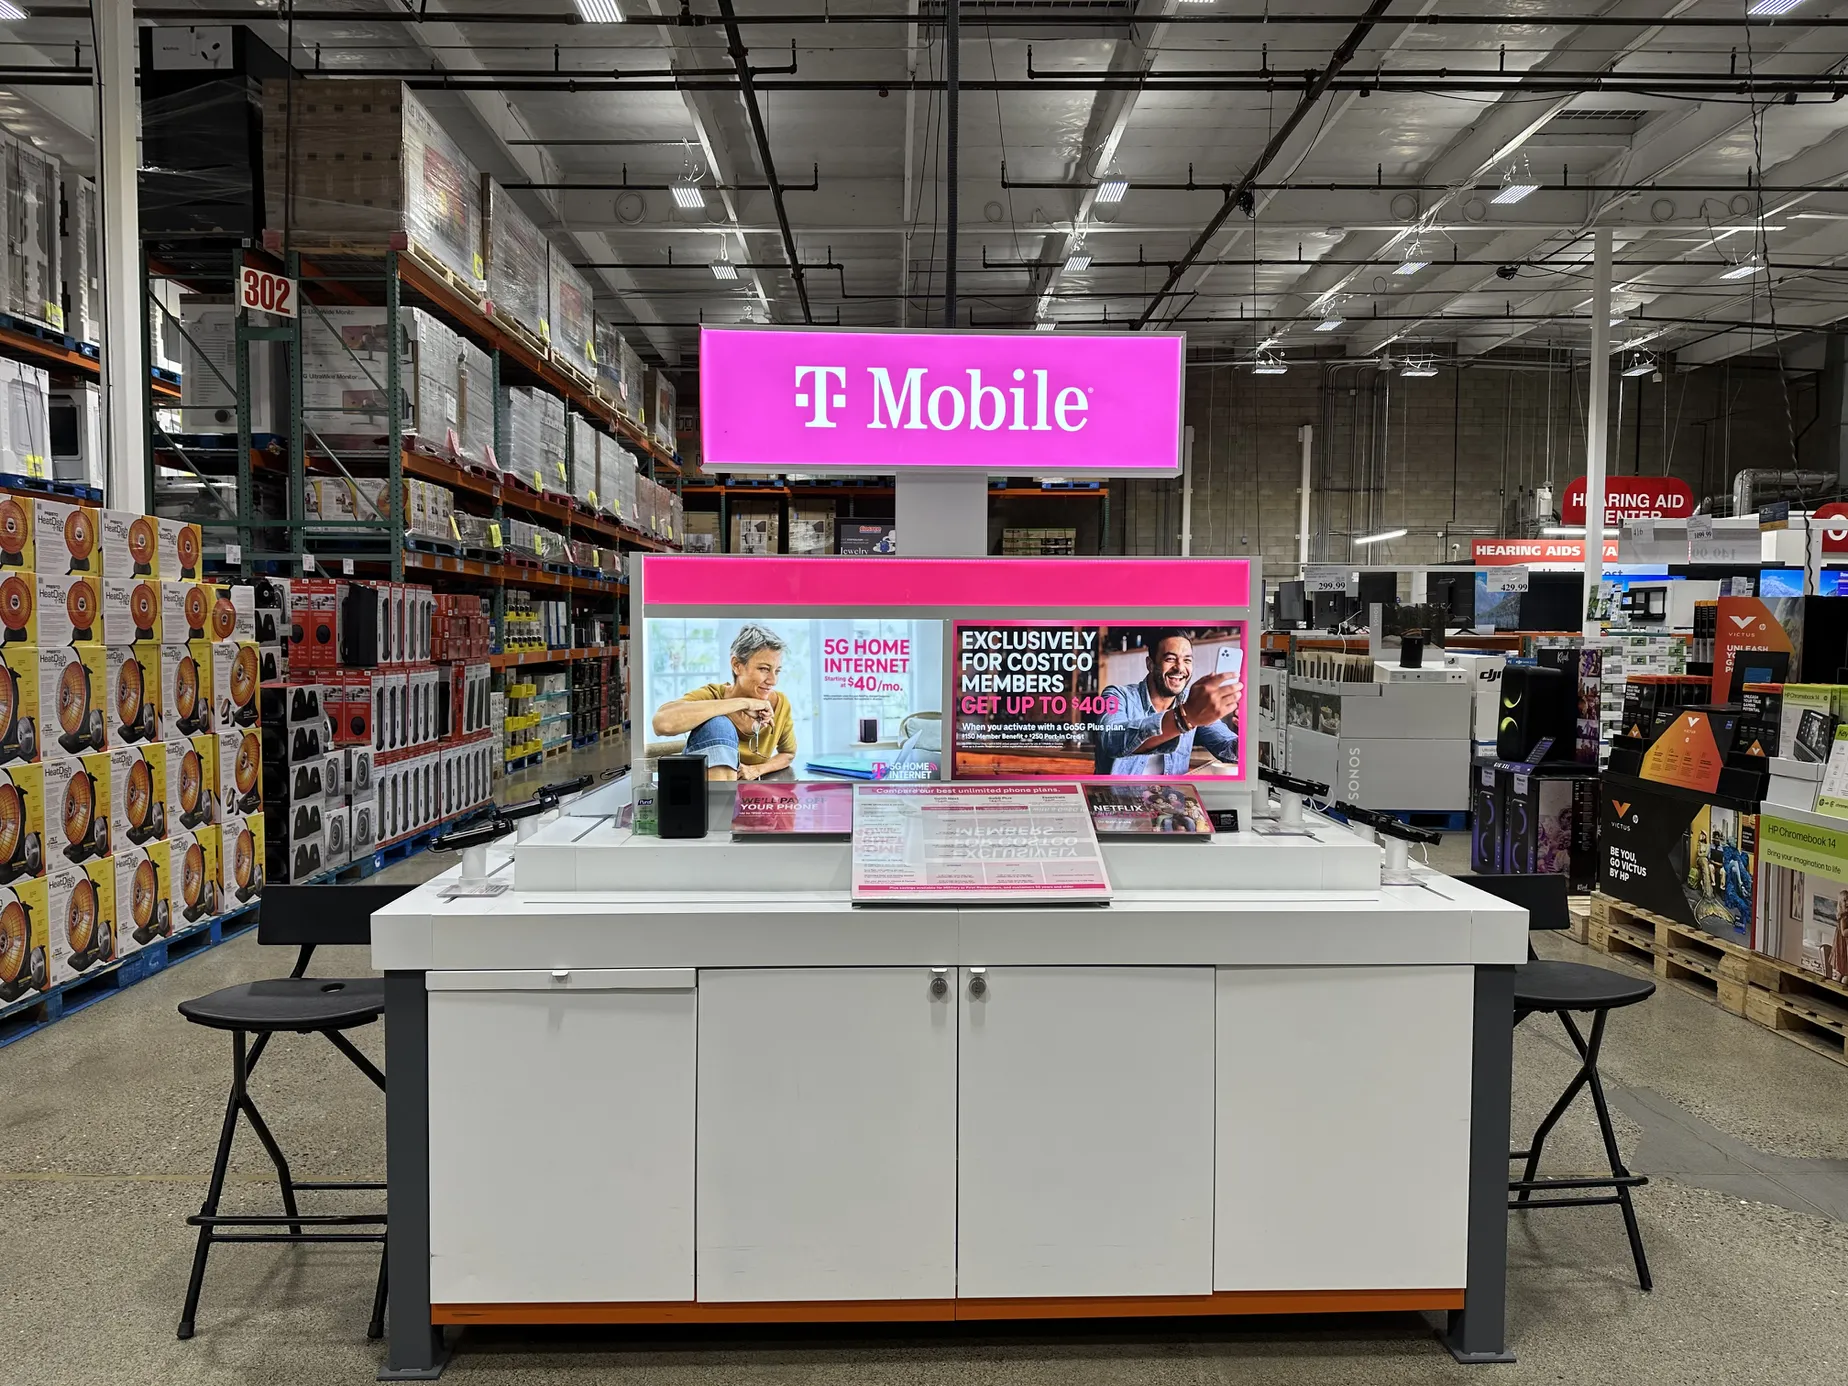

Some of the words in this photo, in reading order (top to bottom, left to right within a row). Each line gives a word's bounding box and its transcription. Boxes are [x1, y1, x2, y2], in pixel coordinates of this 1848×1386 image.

[243, 269, 291, 315] 302
[794, 365, 847, 429] T
[866, 366, 1090, 432] Mobile
[1654, 493, 1685, 509] AID
[37, 515, 64, 529] HeatDish
[104, 524, 129, 534] HeatDish
[1476, 545, 1541, 556] HEARING
[1545, 546, 1581, 556] AIDS
[1319, 582, 1346, 590] 299.99
[1500, 584, 1528, 592] 429.99
[39, 588, 67, 600] HeatDish
[105, 591, 130, 602] HeatDish
[163, 594, 184, 603] HeatDish
[961, 630, 1097, 650] EXCLUSIVELY
[823, 638, 850, 656] 5G
[854, 638, 910, 656] HOME
[39, 653, 67, 664] HeatDish
[961, 652, 1003, 672] FOR
[1006, 652, 1093, 672] COSTCO
[823, 658, 910, 674] INTERNET
[824, 676, 847, 684] Starting
[848, 676, 904, 693] $40/mo.
[961, 674, 1065, 693] MEMBERS
[961, 696, 1001, 715] GET
[1006, 696, 1035, 715] UP
[1039, 696, 1067, 715] TO
[1071, 696, 1120, 715] $400
[962, 722, 986, 731] When
[986, 724, 1002, 733] you
[1003, 722, 1036, 731] activate
[1037, 722, 1056, 731] with
[1063, 723, 1086, 731] Go5G
[1087, 722, 1104, 732] Plus
[1106, 723, 1126, 734] plan.
[44, 766, 72, 778] HeatDish
[889, 762, 902, 770] 5G
[903, 762, 930, 770] HOME
[889, 770, 932, 779] INTERNET
[1348, 748, 1360, 800] SONOS
[876, 788, 919, 796] Compare
[1003, 787, 1032, 795] phone
[1033, 786, 1061, 795] plans.
[740, 803, 774, 811] YOUR
[776, 803, 819, 811] PHONE
[1093, 804, 1144, 812] NETFLIX
[1610, 821, 1631, 832] VICTUS
[1768, 824, 1779, 835] HP
[1780, 826, 1827, 847] Chromebook
[1828, 838, 1836, 849] 14
[1610, 846, 1620, 857] BE
[1620, 848, 1637, 864] YOU,
[1767, 848, 1781, 860] Bring
[1780, 853, 1793, 862] your
[1793, 855, 1825, 871] imagination
[1825, 864, 1832, 872] to
[1832, 865, 1842, 875] life
[115, 857, 139, 869] HeatDish
[1609, 856, 1621, 868] GO
[1621, 860, 1647, 877] VICTUS
[1609, 867, 1619, 878] BY
[1619, 871, 1630, 882] HP
[48, 876, 76, 889] HeatDish
